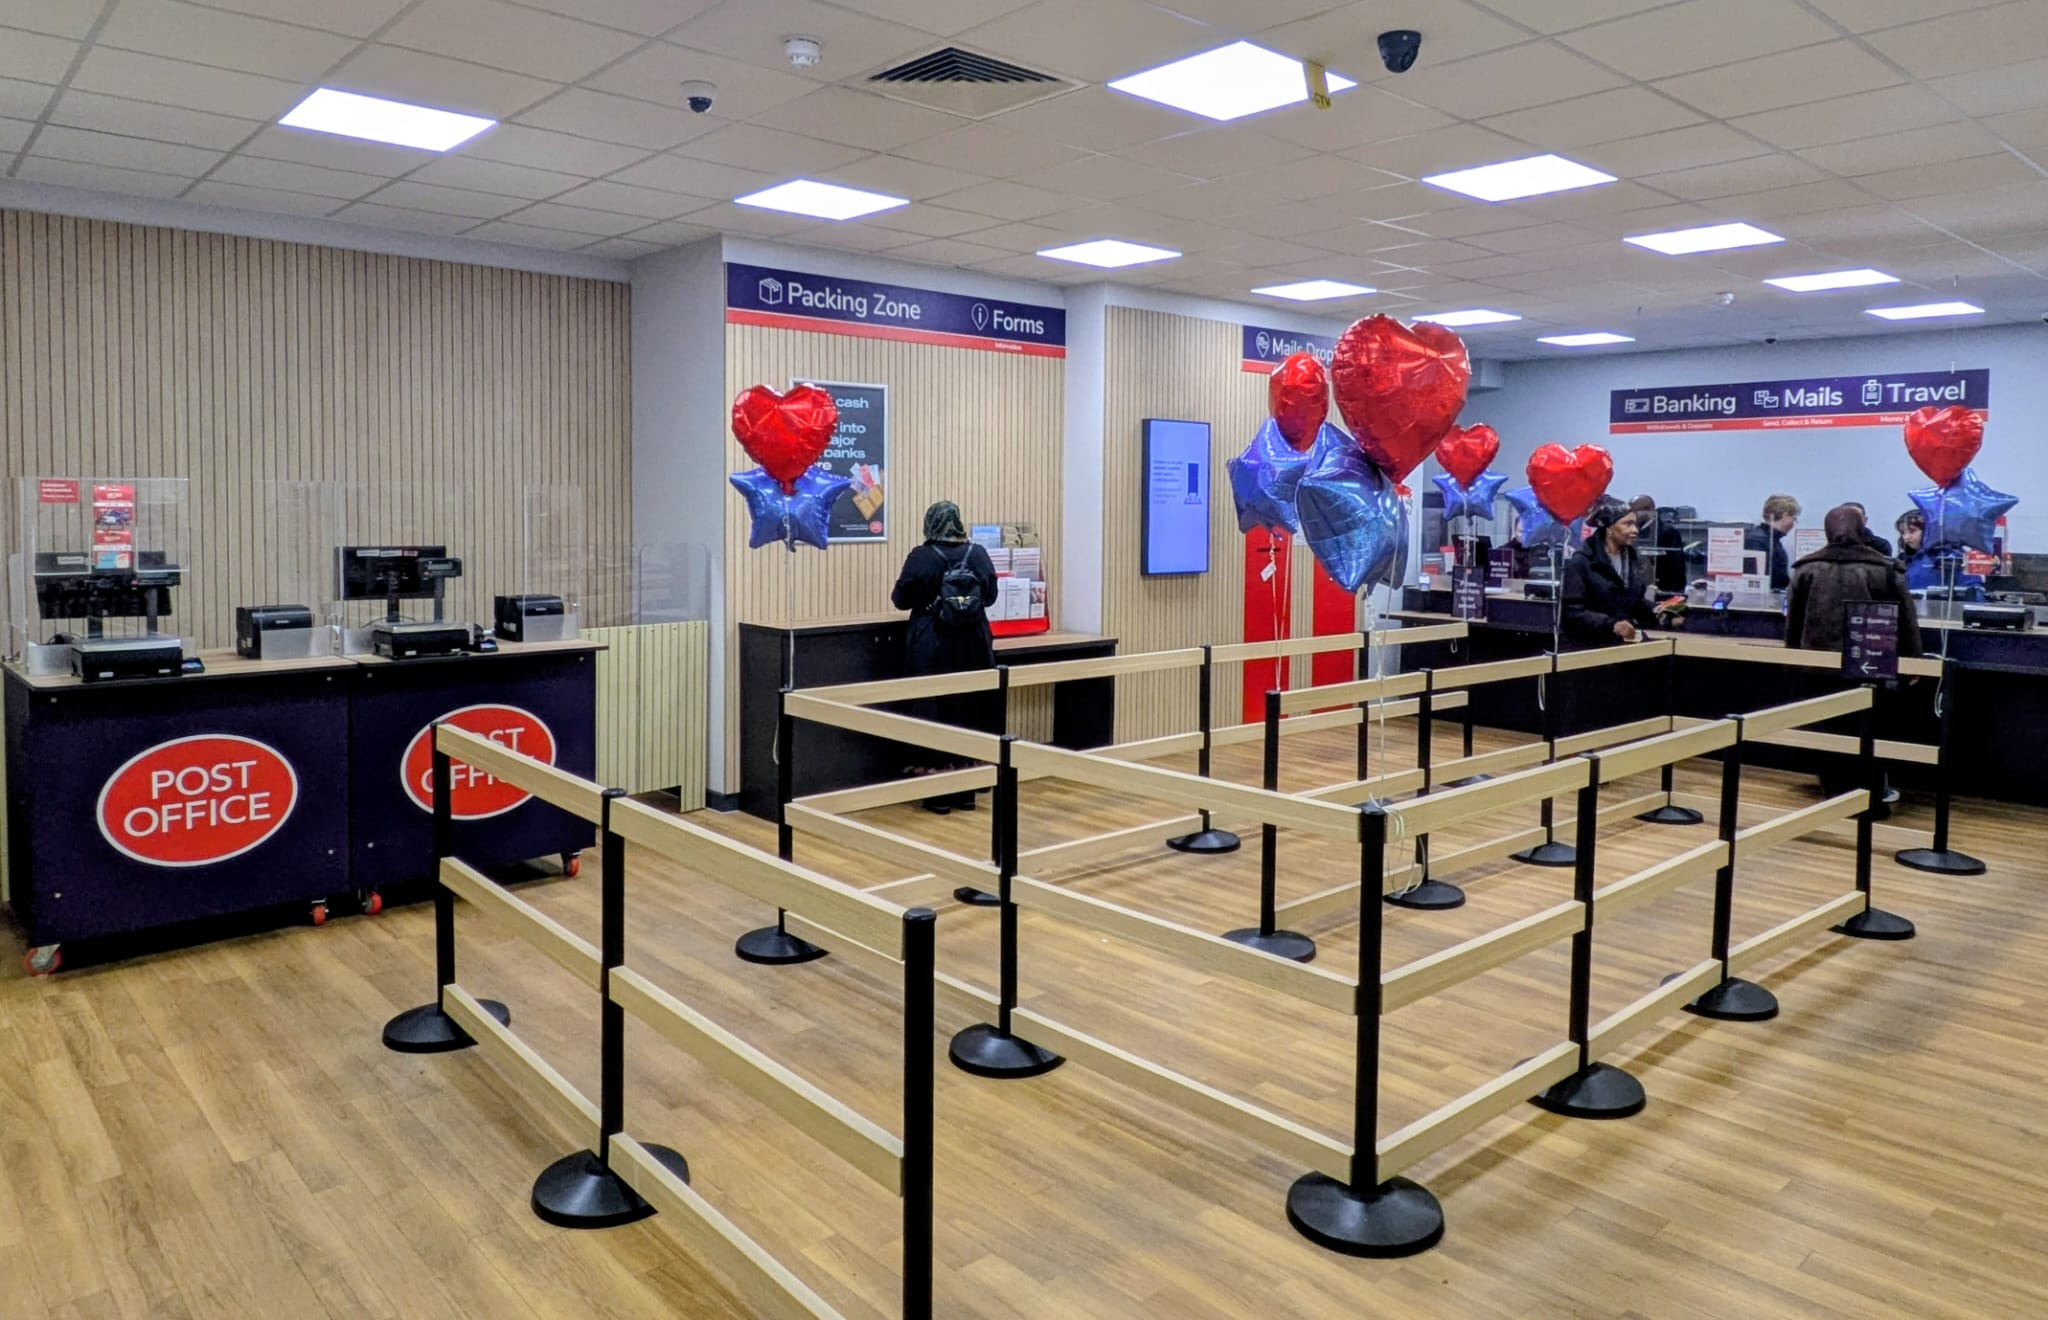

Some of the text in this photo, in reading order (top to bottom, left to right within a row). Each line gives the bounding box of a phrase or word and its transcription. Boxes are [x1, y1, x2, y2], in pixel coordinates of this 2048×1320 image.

[788, 282, 921, 320] Packing Zone
[993, 309, 1044, 335] Forms
[835, 398, 869, 409] cash
[1653, 380, 1966, 415] Banking Mails Travel
[829, 434, 857, 448] ajor
[839, 421, 866, 434] into
[151, 760, 257, 800] POST
[123, 791, 271, 838] OFFICE
